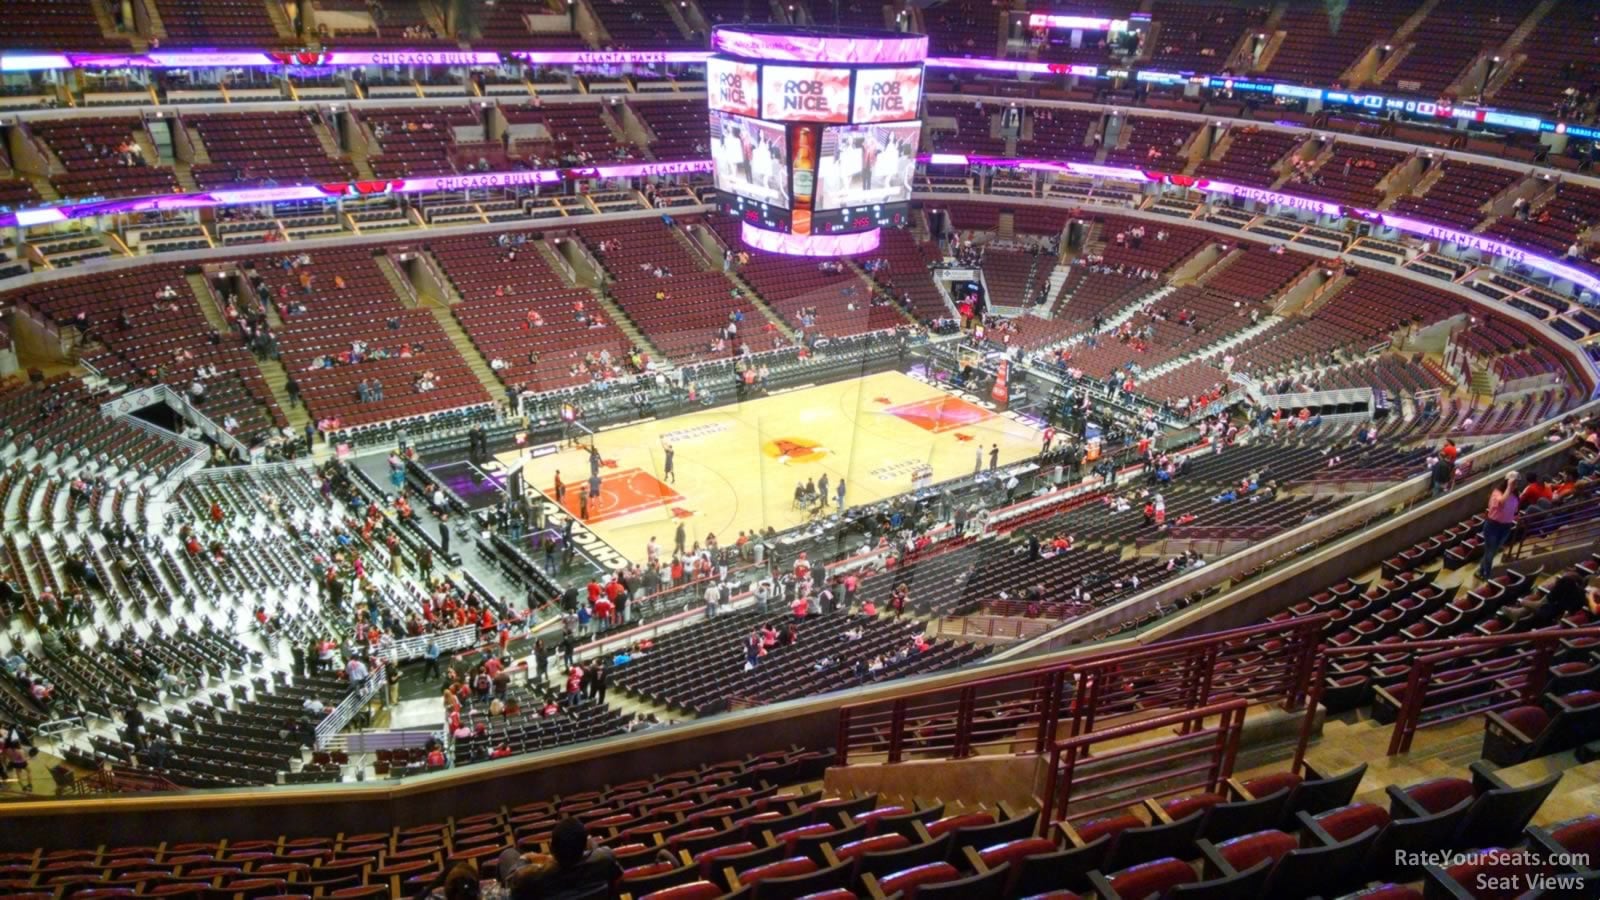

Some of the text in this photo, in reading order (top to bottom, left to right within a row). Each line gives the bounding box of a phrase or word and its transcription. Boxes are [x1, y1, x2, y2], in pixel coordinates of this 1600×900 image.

[371, 53, 479, 64] CHICAGO BULLS
[577, 53, 666, 63] ATLANTA HAWKS
[719, 72, 742, 89] ROB
[783, 79, 824, 95] ROB
[871, 81, 901, 96] ROB
[719, 87, 747, 106] NICE
[783, 95, 831, 112] NICE
[869, 96, 904, 113] NICE
[641, 161, 714, 176] ATLANTA HAW
[436, 172, 542, 190] CHICAGO BULLS
[1233, 186, 1324, 212] CHICAGO BULLS
[1428, 227, 1526, 262] ATLANTA HAWKS
